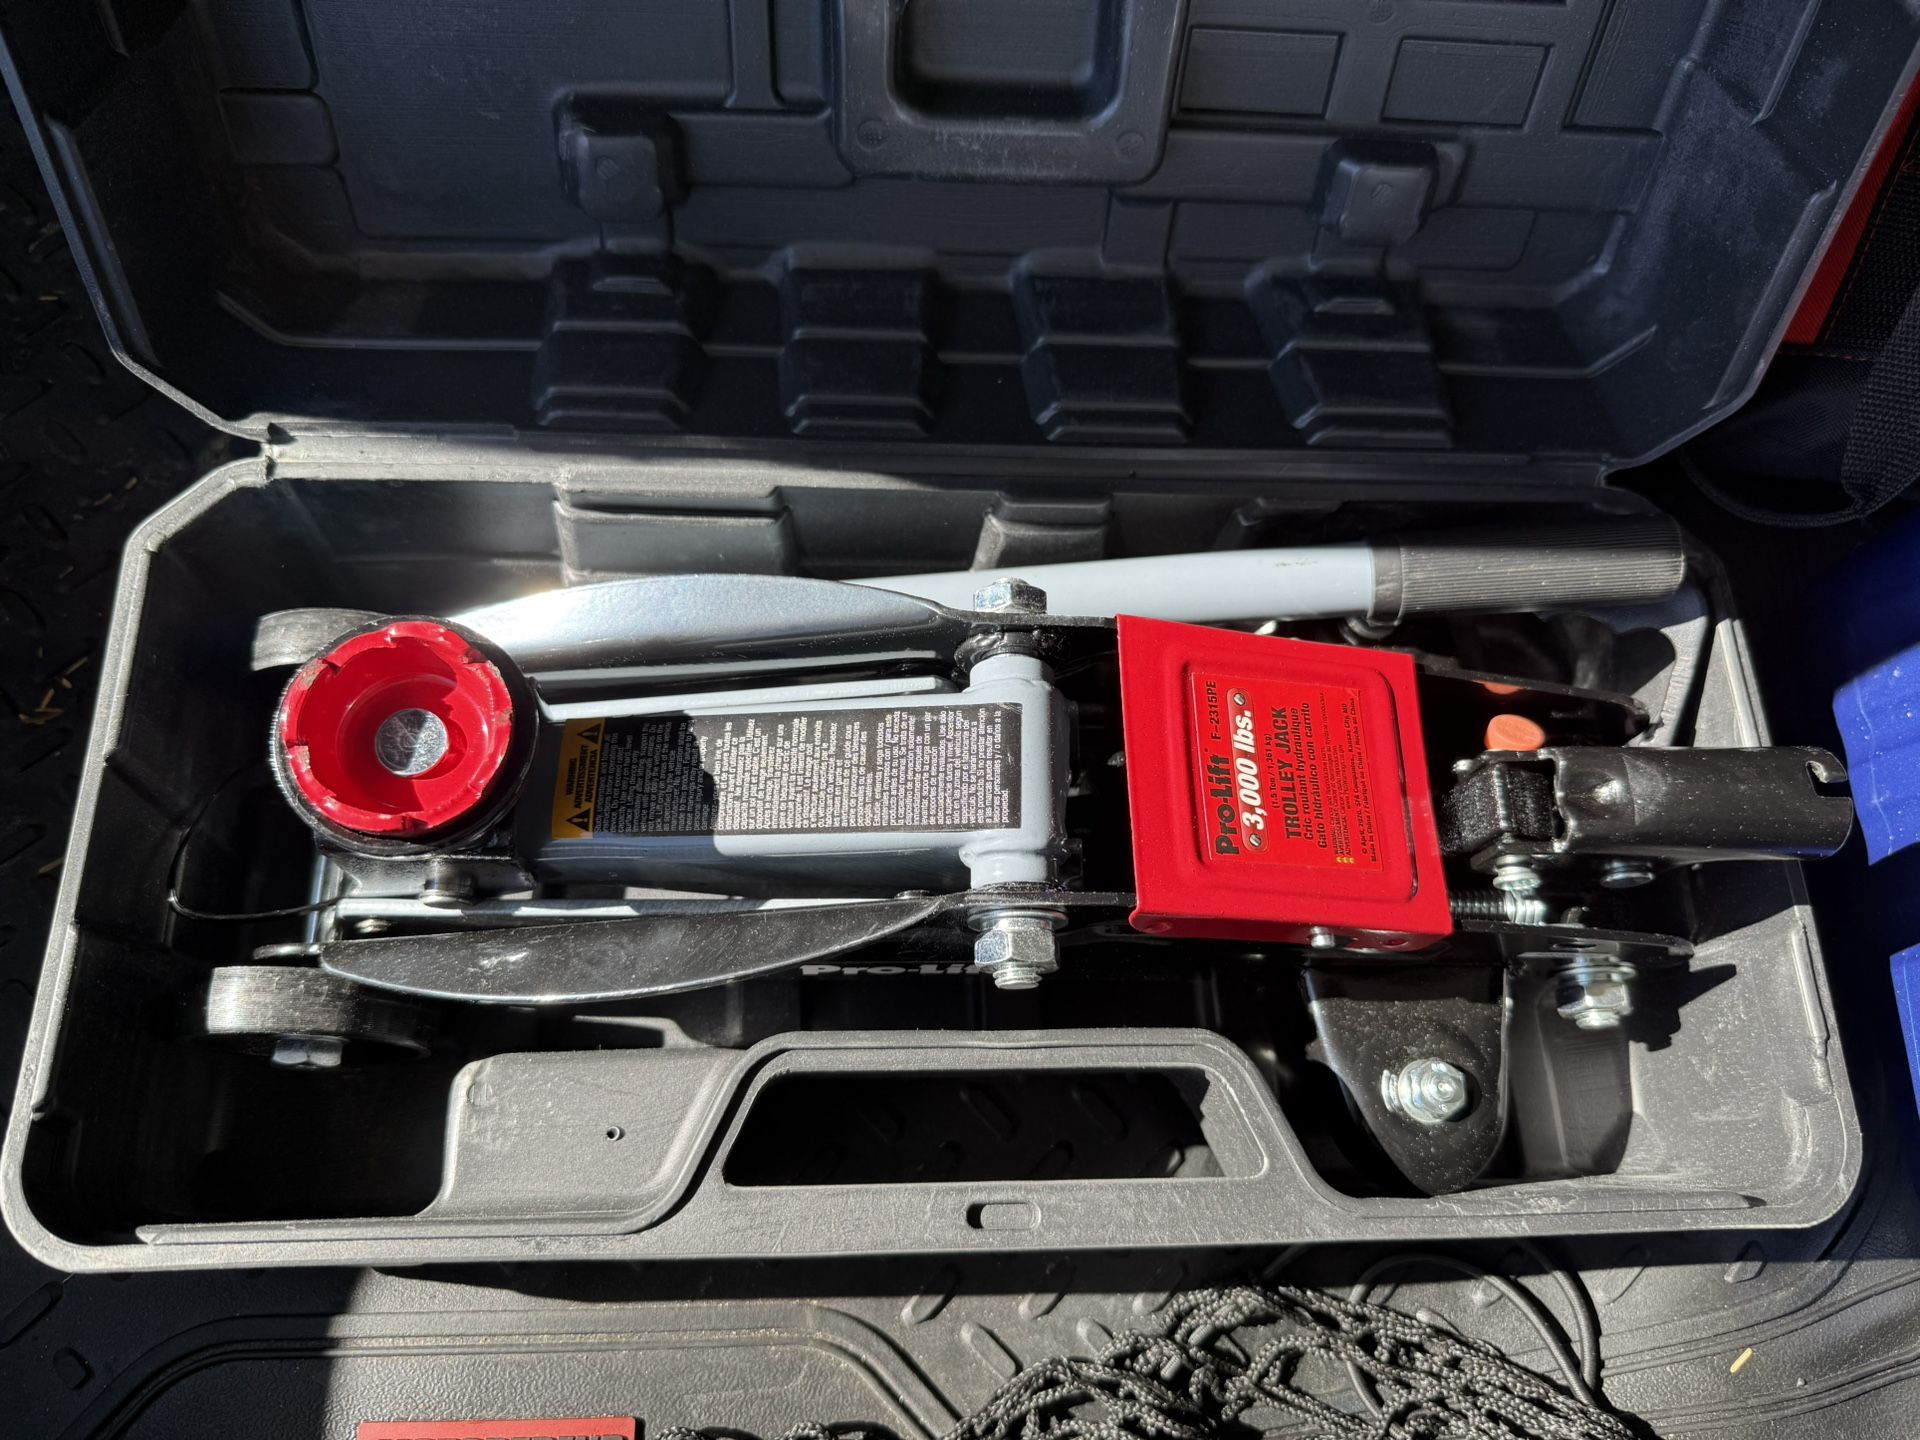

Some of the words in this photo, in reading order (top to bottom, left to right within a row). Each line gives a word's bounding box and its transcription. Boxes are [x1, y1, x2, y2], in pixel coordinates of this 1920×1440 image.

[1232, 710, 1254, 752] lbs.
[1271, 707, 1290, 753] JACK
[1301, 702, 1312, 737] carrito
[1263, 733, 1272, 746] kg)
[1290, 708, 1305, 771] hydraulique
[1306, 741, 1315, 760] con
[1265, 748, 1274, 769] 1,361
[1207, 755, 1239, 854] Pro-Lift
[1235, 757, 1266, 829] 3,000
[1269, 792, 1280, 808] (1.5
[1277, 760, 1301, 838] TROLLEY
[1297, 774, 1310, 814] roulant
[1302, 817, 1314, 840] Cric
[1316, 822, 1327, 848] Gato
